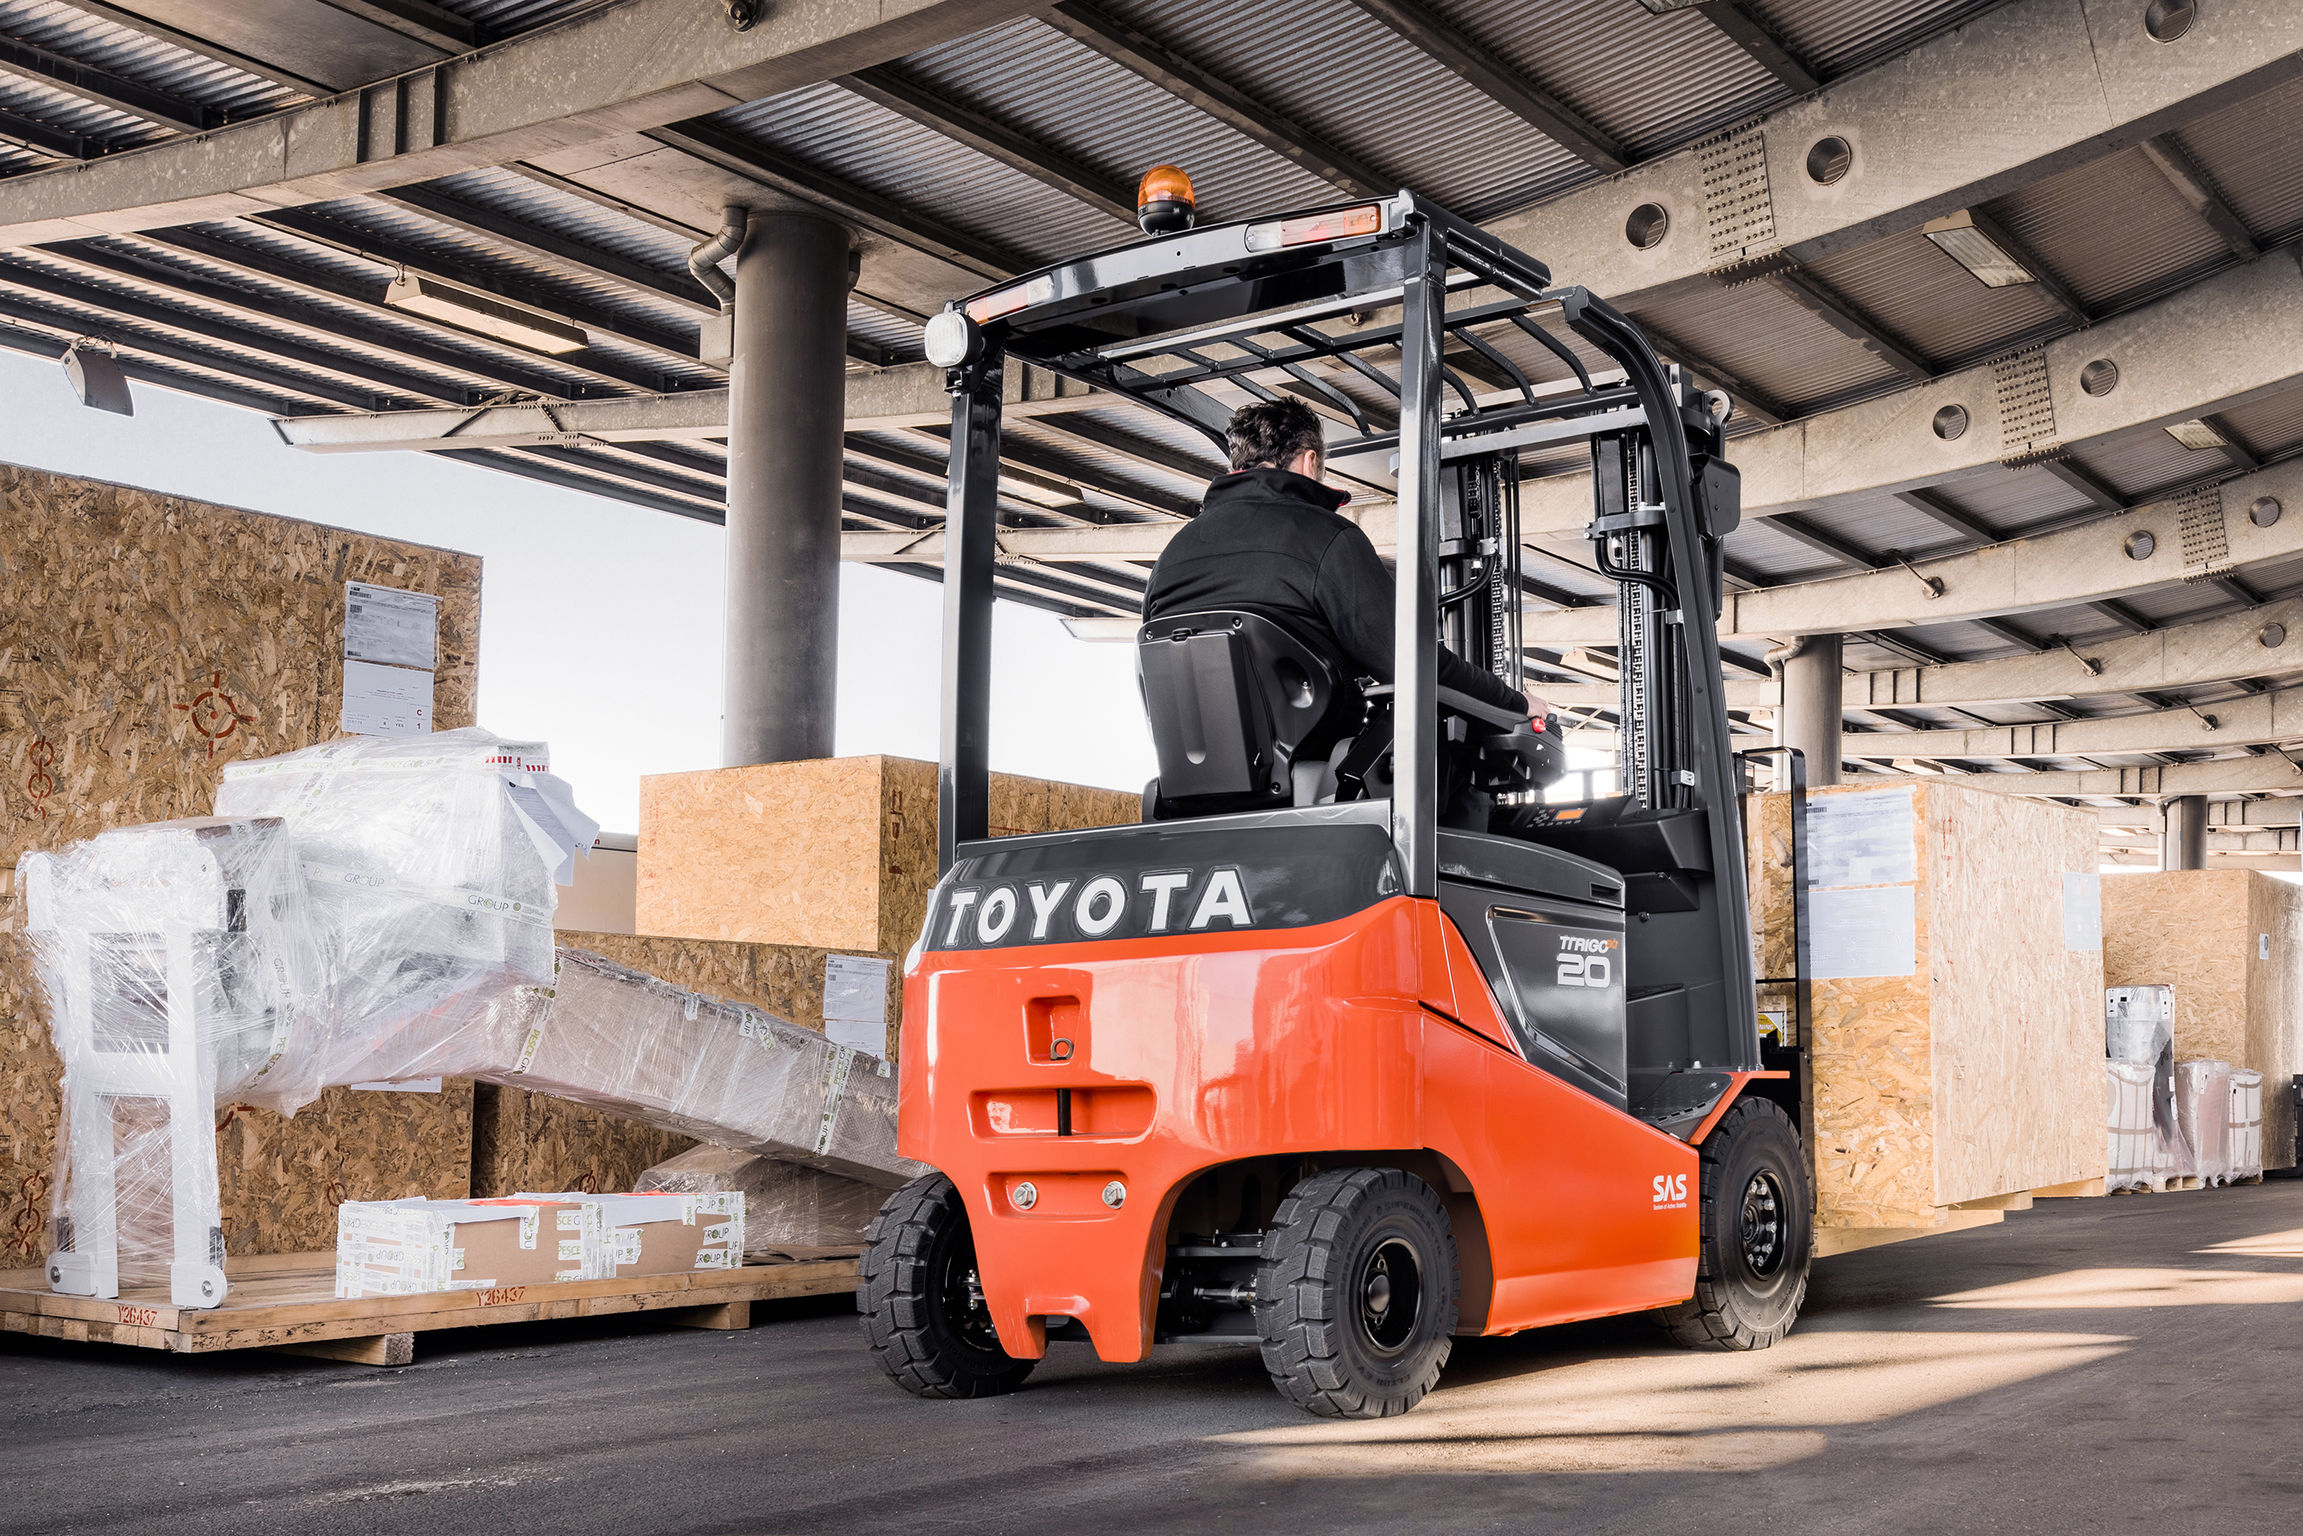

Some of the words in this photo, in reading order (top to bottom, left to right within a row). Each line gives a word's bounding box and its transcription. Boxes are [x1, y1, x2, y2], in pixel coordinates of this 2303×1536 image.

[467, 895, 509, 912] GROUP
[944, 869, 1254, 947] TOYOTA
[1556, 953, 1610, 988] 20
[524, 1028, 541, 1057] PESCE
[1652, 1173, 1687, 1202] SAS
[476, 1286, 526, 1306] Y26437
[117, 1306, 158, 1327] Y26437
